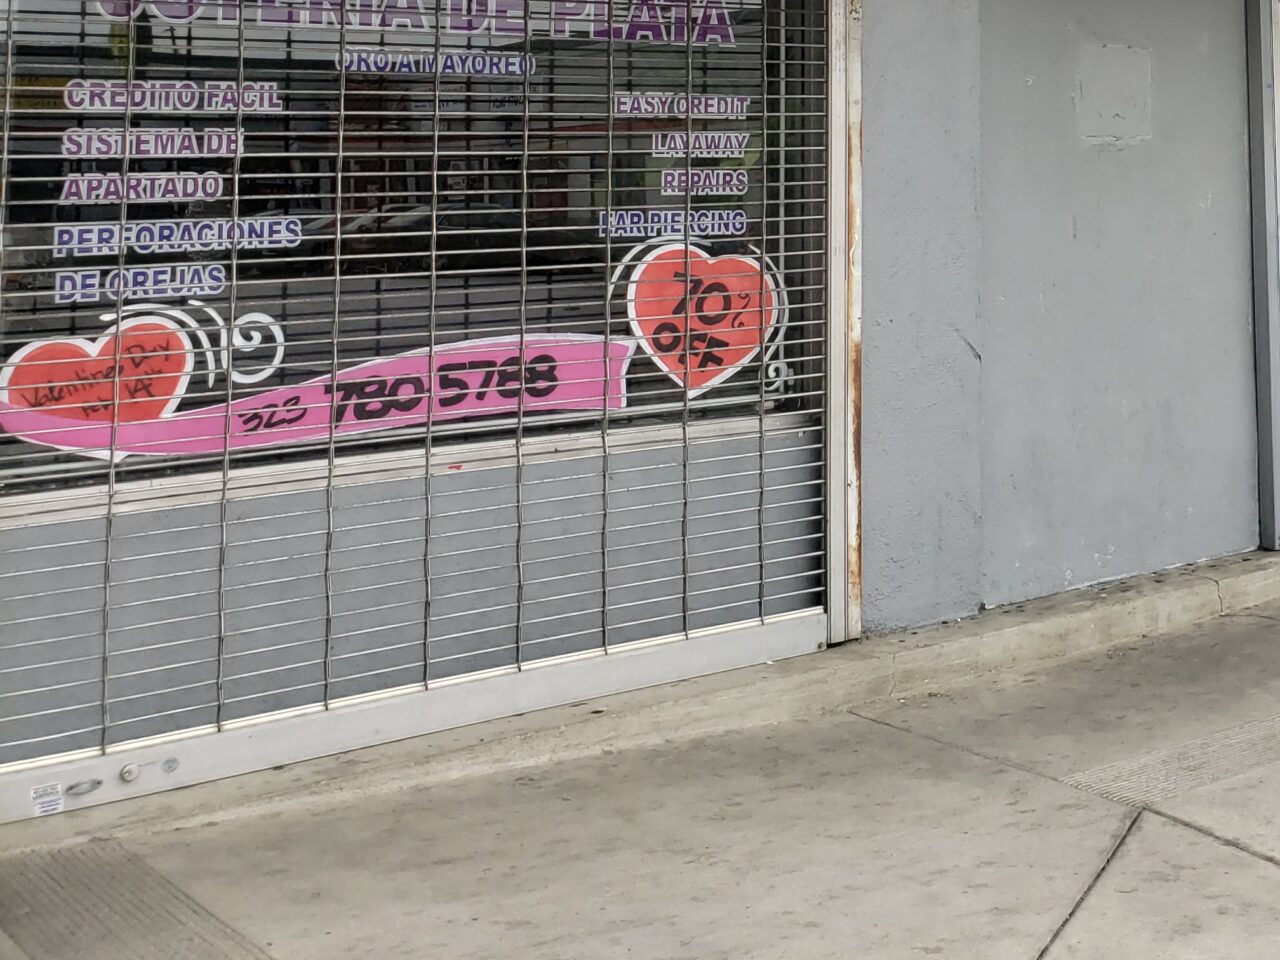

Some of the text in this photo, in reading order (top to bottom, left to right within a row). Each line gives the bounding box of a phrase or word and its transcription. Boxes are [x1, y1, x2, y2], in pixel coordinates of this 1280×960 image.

[335, 48, 536, 75] ORO A MAYOREO
[64, 79, 199, 111] CREDITO
[203, 81, 283, 112] FACIL
[614, 92, 751, 120] EASY CREDIT
[61, 128, 245, 159] SISTEMA DE
[652, 133, 750, 158] LAYAWAY
[58, 171, 224, 205] APARTADO
[661, 169, 749, 196] REPAIRS
[53, 218, 302, 258] PERFORACIONES
[599, 209, 747, 238] EAR PIERCING
[55, 264, 227, 304] DE OREJAS
[671, 271, 752, 330] 70%
[126, 337, 172, 369] Day
[652, 321, 730, 373] OFF
[238, 353, 559, 432] 323 780 5788
